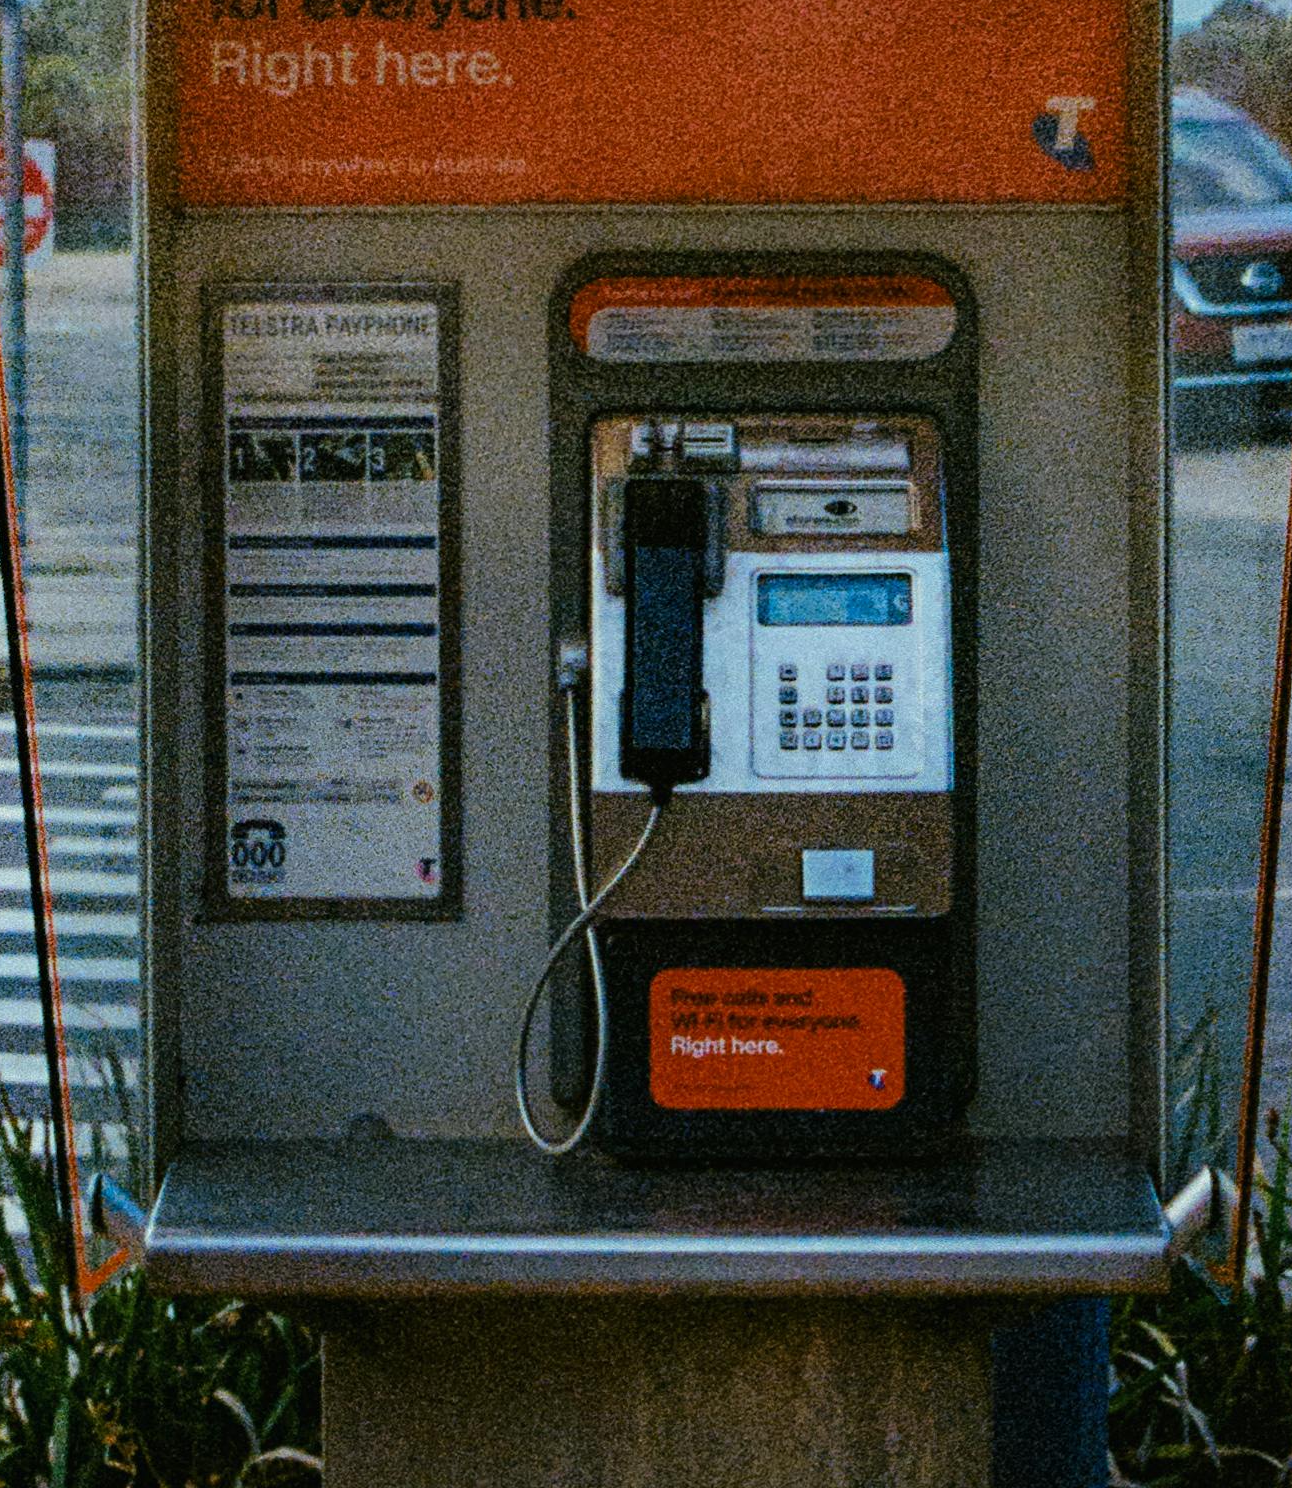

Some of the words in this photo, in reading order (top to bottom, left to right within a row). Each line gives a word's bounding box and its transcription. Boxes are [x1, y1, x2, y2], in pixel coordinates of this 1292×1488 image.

[209, 39, 360, 97] Right
[376, 40, 515, 86] here.
[229, 314, 319, 336] TELSTRA
[234, 447, 246, 470] 1
[303, 447, 317, 471] 2
[371, 447, 386, 472] 3
[232, 841, 286, 868] 000
[671, 988, 717, 1006] Free
[723, 989, 768, 1006] calls
[774, 988, 813, 1006] and
[729, 1012, 757, 1029] for
[670, 1035, 726, 1059] Right
[731, 1035, 784, 1055] here.
